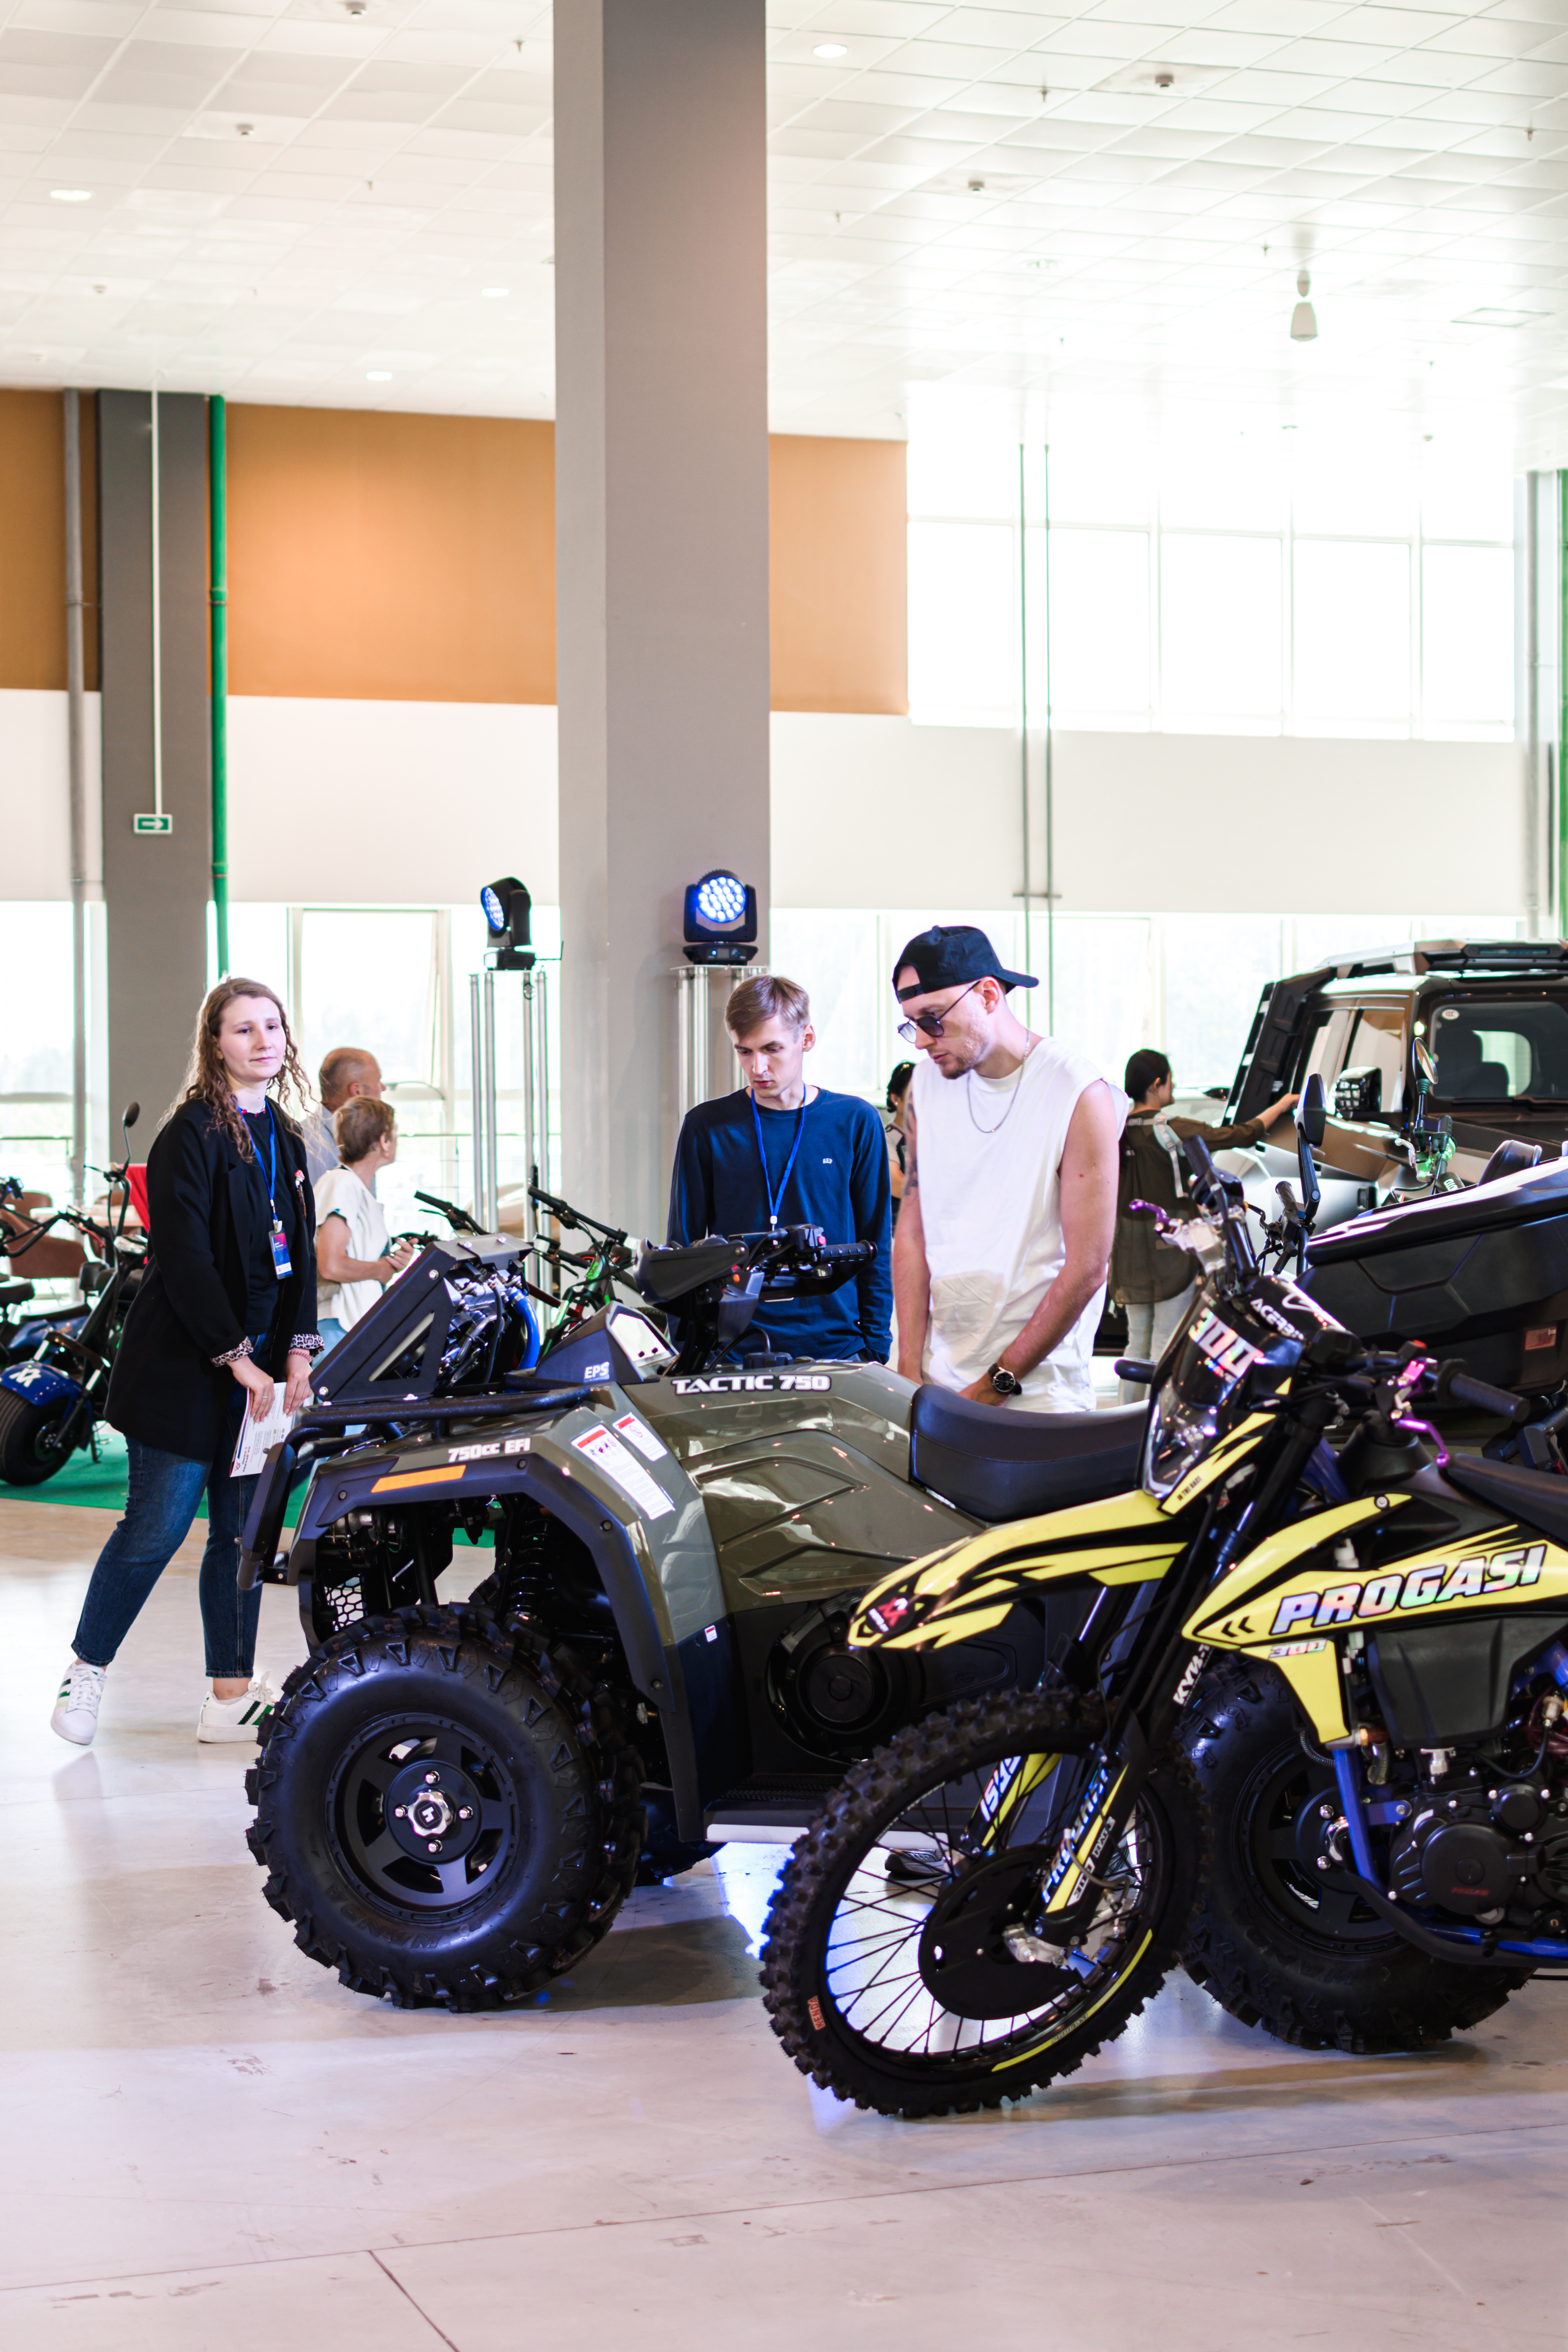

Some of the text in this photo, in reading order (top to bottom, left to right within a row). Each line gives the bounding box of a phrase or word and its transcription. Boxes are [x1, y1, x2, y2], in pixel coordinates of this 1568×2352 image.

[584, 1361, 609, 1378] EPS
[672, 1375, 830, 1394] TACTIC 750
[448, 1437, 531, 1463] 750cc EFI
[1269, 1543, 1547, 1636] PROGASI
[1268, 1640, 1327, 1659] 300
[807, 1996, 824, 2031] KENDA
